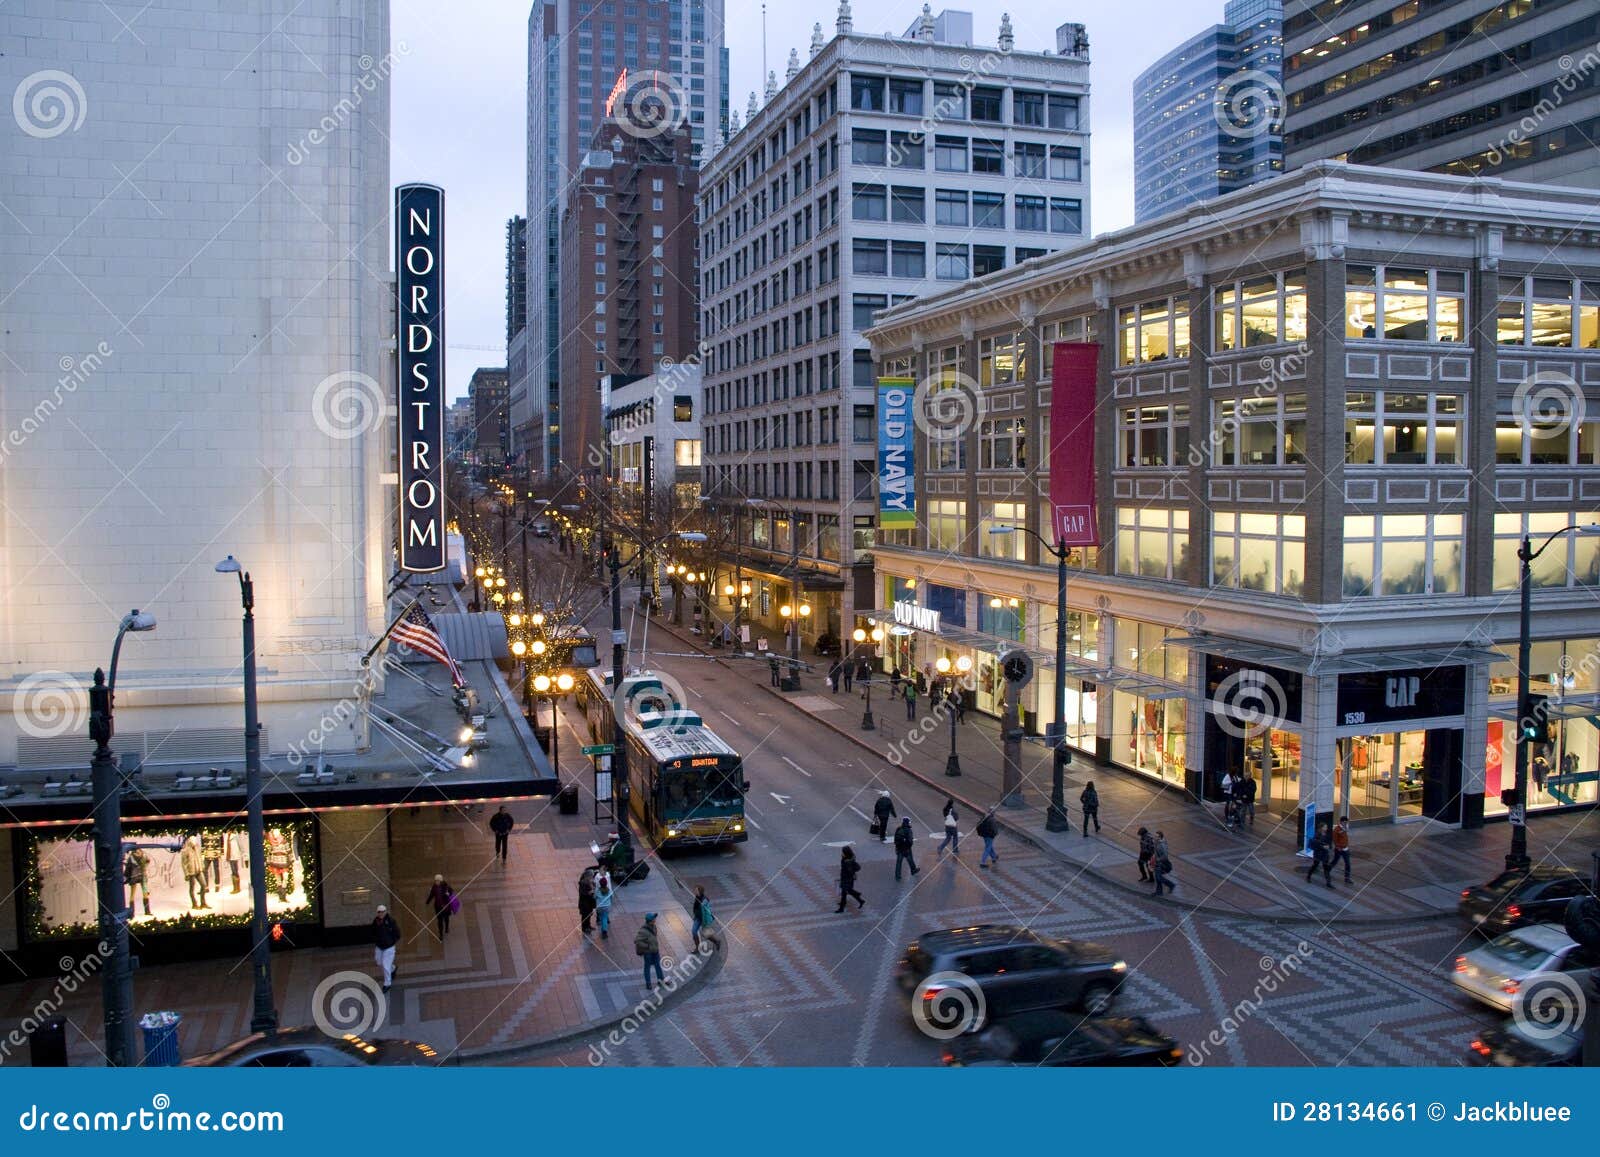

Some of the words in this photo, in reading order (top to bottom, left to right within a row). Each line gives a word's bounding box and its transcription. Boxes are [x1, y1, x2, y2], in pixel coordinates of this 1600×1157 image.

[406, 207, 437, 547] NORDSTROM
[886, 389, 906, 439] OLD
[886, 444, 907, 511] NAVY
[1063, 515, 1085, 532] GAP
[894, 600, 912, 625] OLD
[913, 605, 940, 633] NAVY
[1385, 676, 1420, 708] GAP
[1345, 711, 1365, 725] 1530
